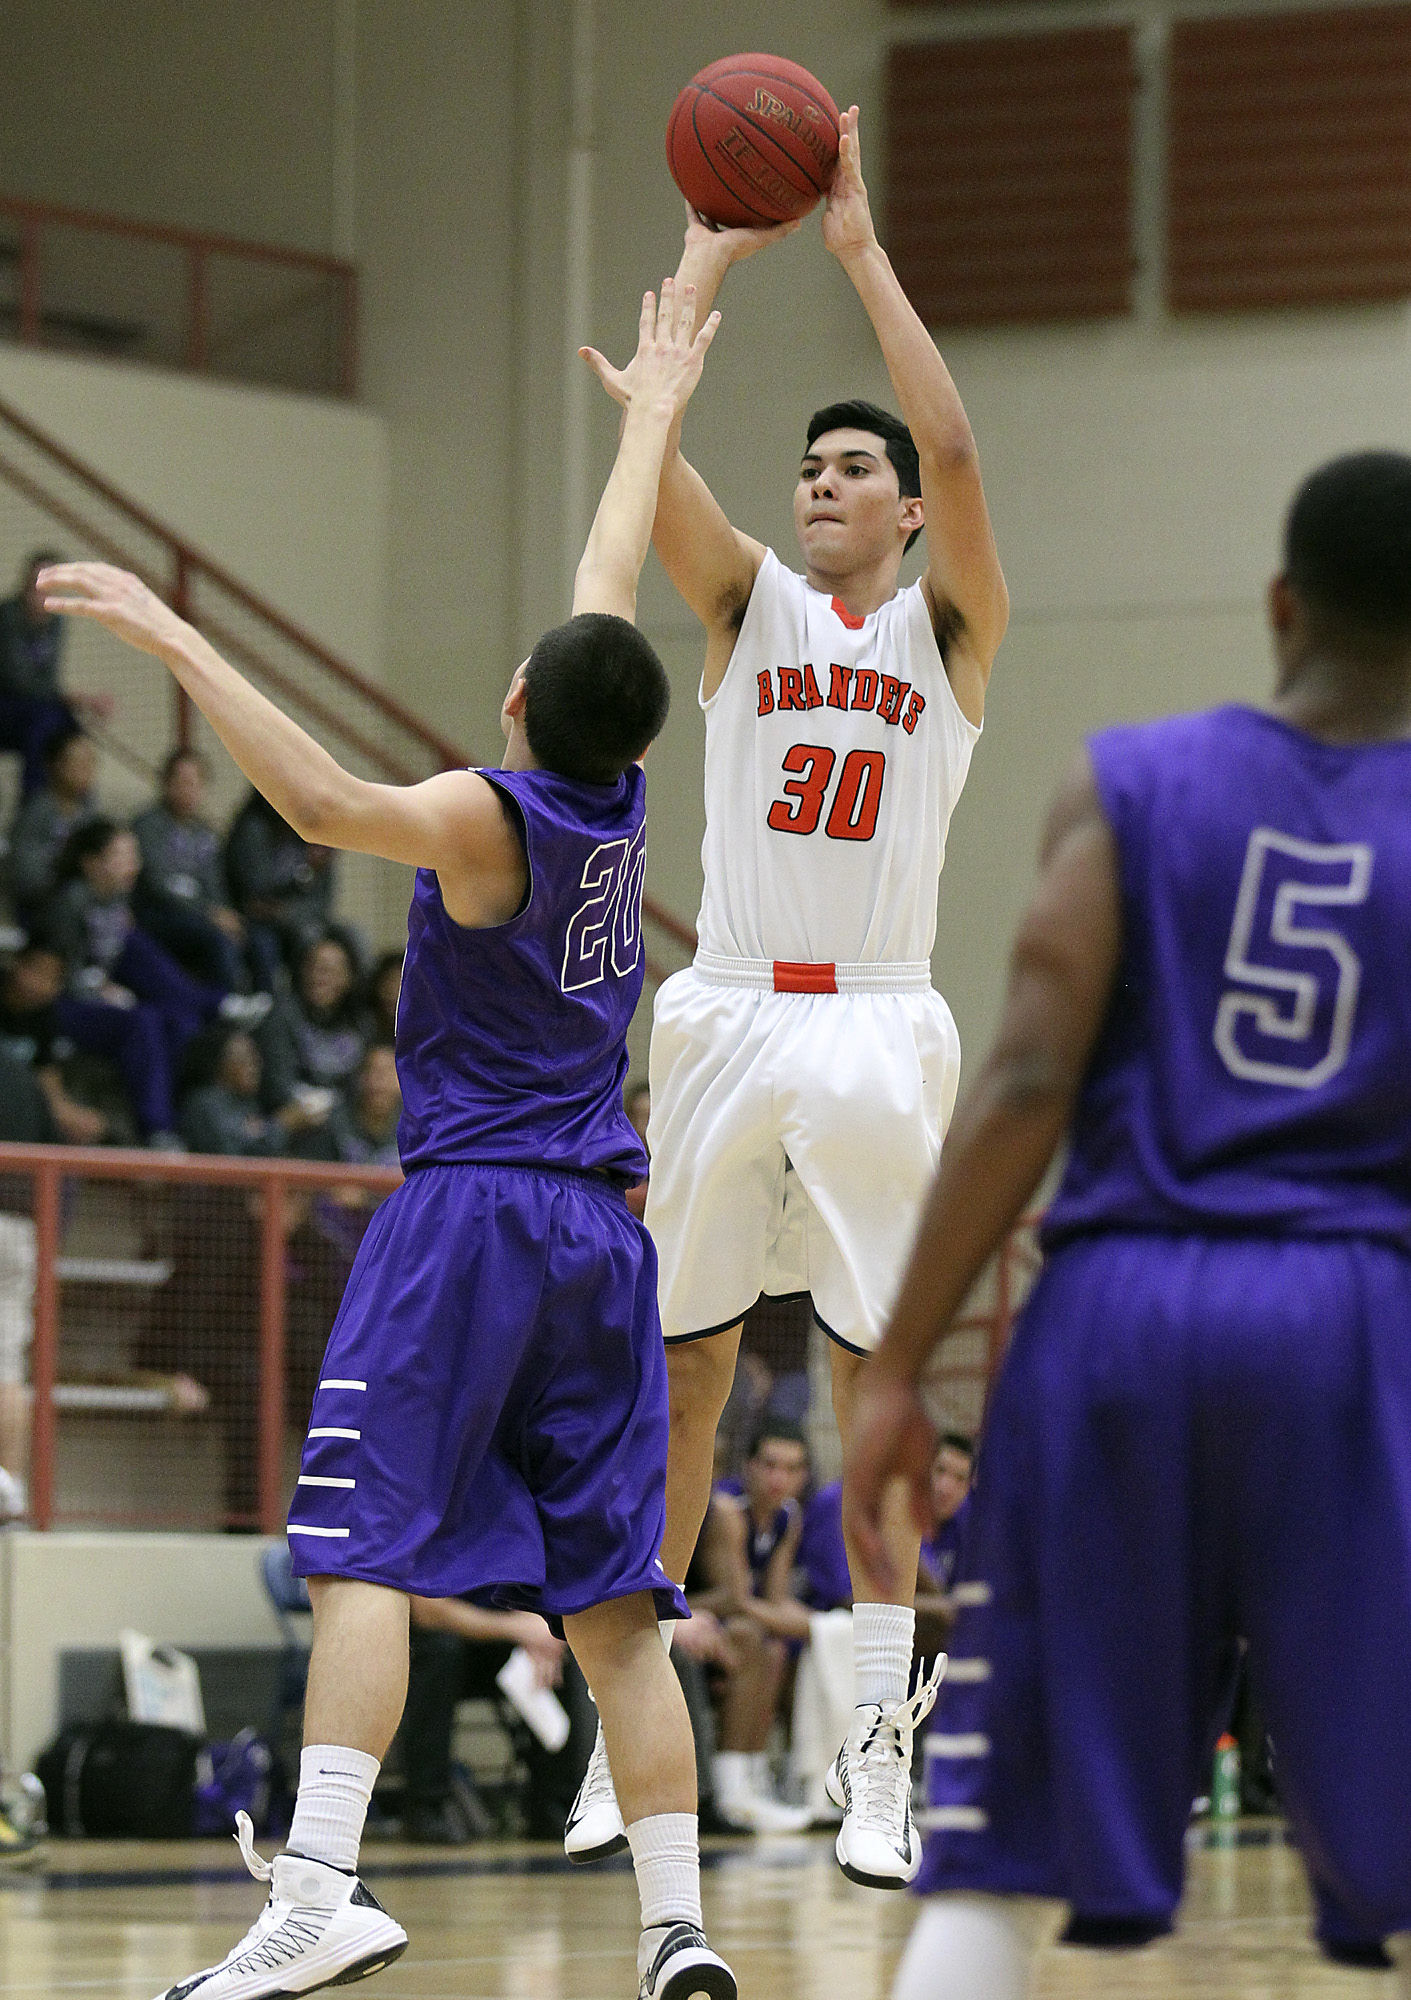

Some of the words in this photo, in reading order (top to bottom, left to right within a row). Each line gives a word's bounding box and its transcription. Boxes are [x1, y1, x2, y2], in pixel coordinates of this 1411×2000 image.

[757, 663, 926, 735] BRANDEIS
[767, 743, 886, 841] 30
[561, 816, 647, 992] 20
[1212, 826, 1374, 1088] 5
